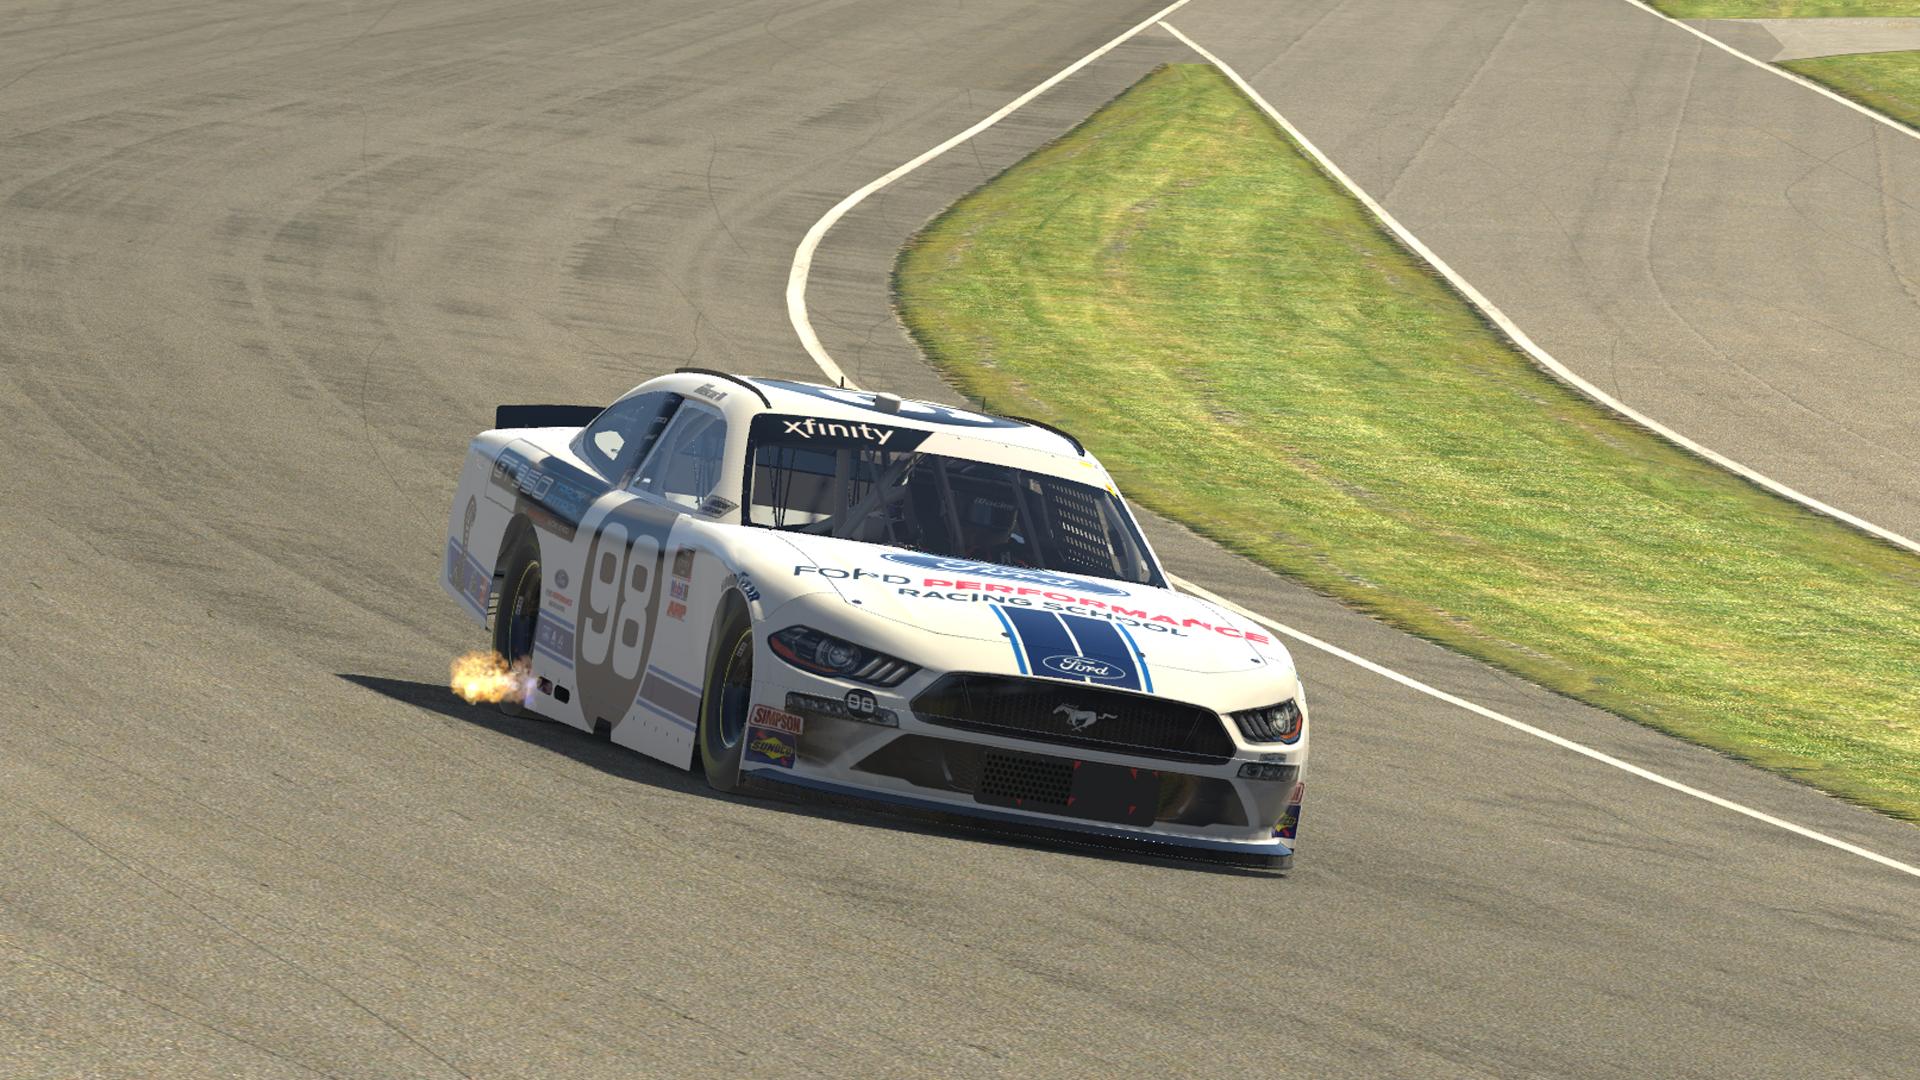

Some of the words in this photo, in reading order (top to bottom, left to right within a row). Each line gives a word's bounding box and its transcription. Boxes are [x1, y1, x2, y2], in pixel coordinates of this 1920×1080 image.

[783, 418, 894, 445] xfinity
[581, 521, 660, 680] 98
[793, 565, 911, 585] FORD
[923, 578, 1270, 645] PERFORMANCE
[898, 587, 1033, 606] RACING
[1043, 601, 1188, 637] SCHOOL
[1059, 658, 1109, 676] Ford
[754, 707, 801, 732] SIMPSON
[751, 741, 793, 757] SUNOCO
